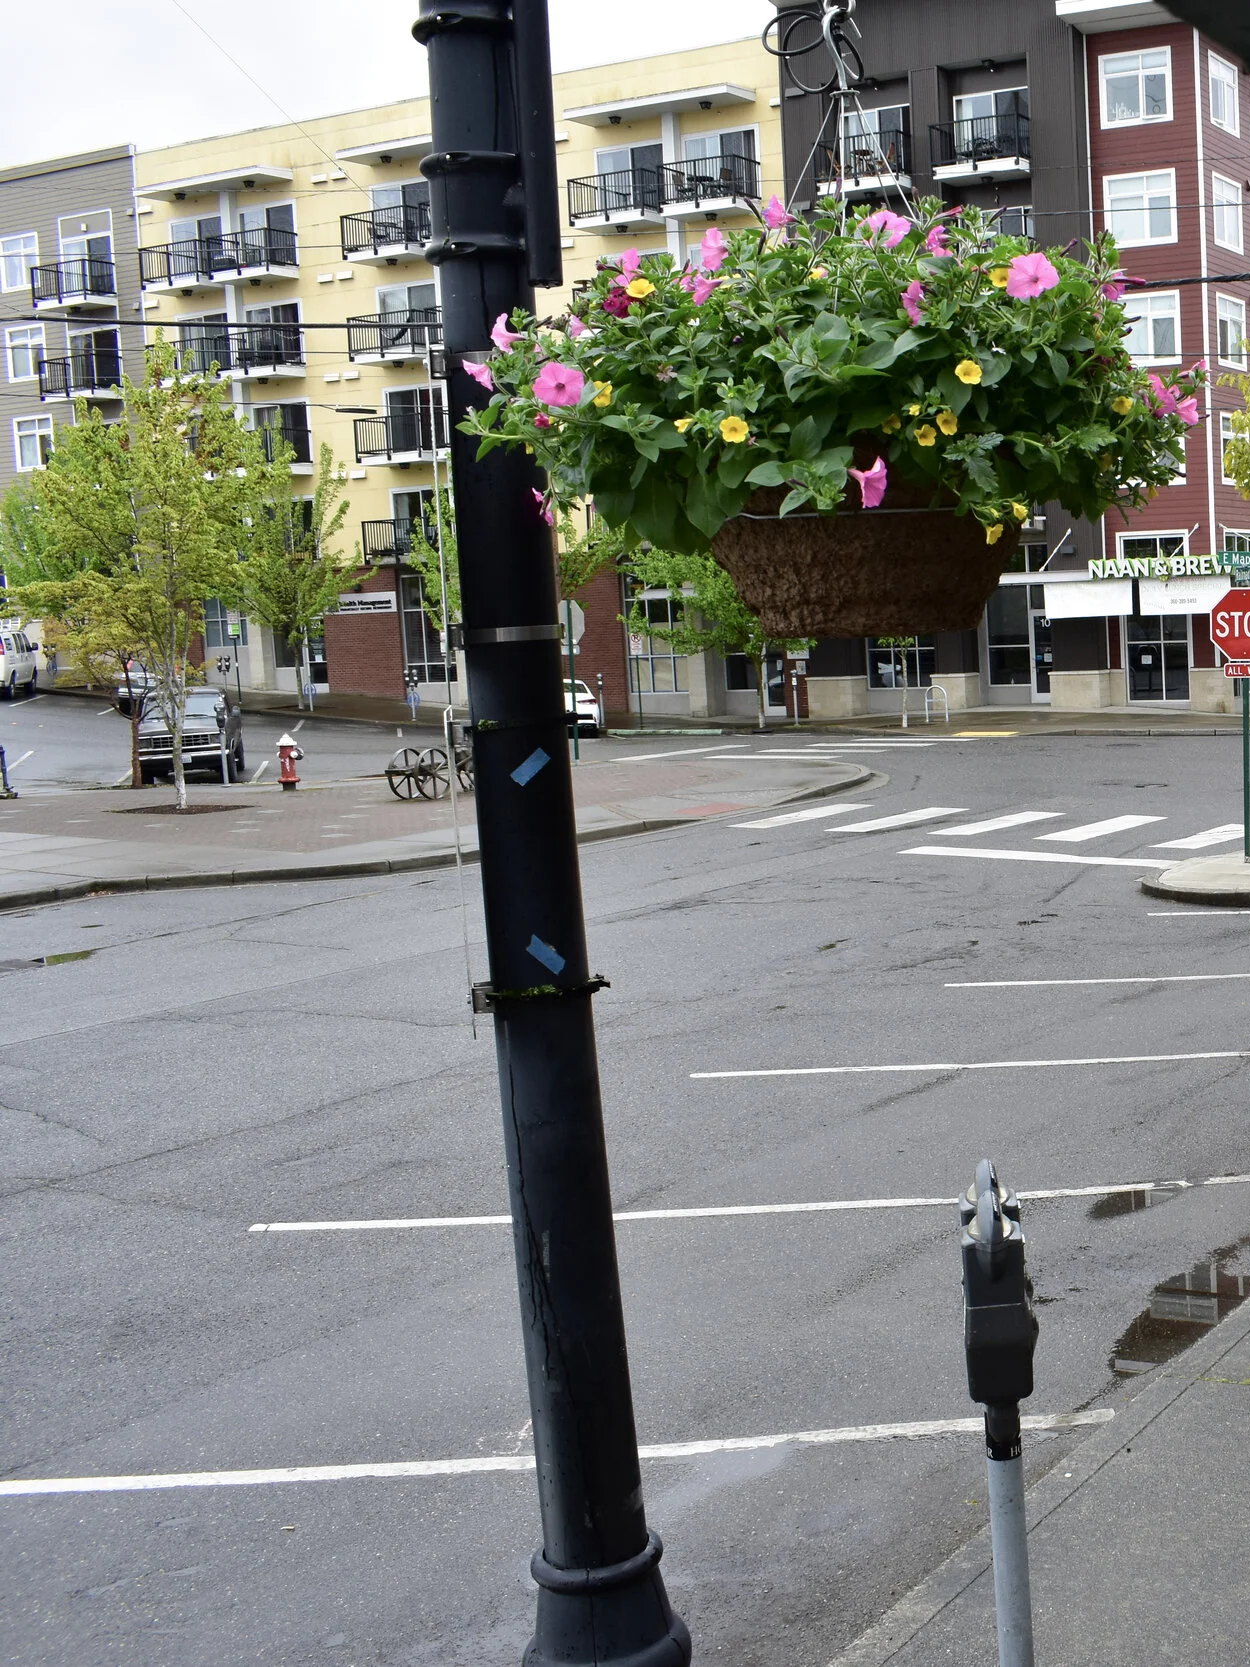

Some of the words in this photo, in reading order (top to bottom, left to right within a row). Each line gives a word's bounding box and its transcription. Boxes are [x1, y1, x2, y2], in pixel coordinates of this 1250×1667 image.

[1223, 553, 1228, 563] E
[1088, 558, 1150, 579] NAAN
[1155, 560, 1168, 576] &
[1228, 666, 1242, 675] ALL
